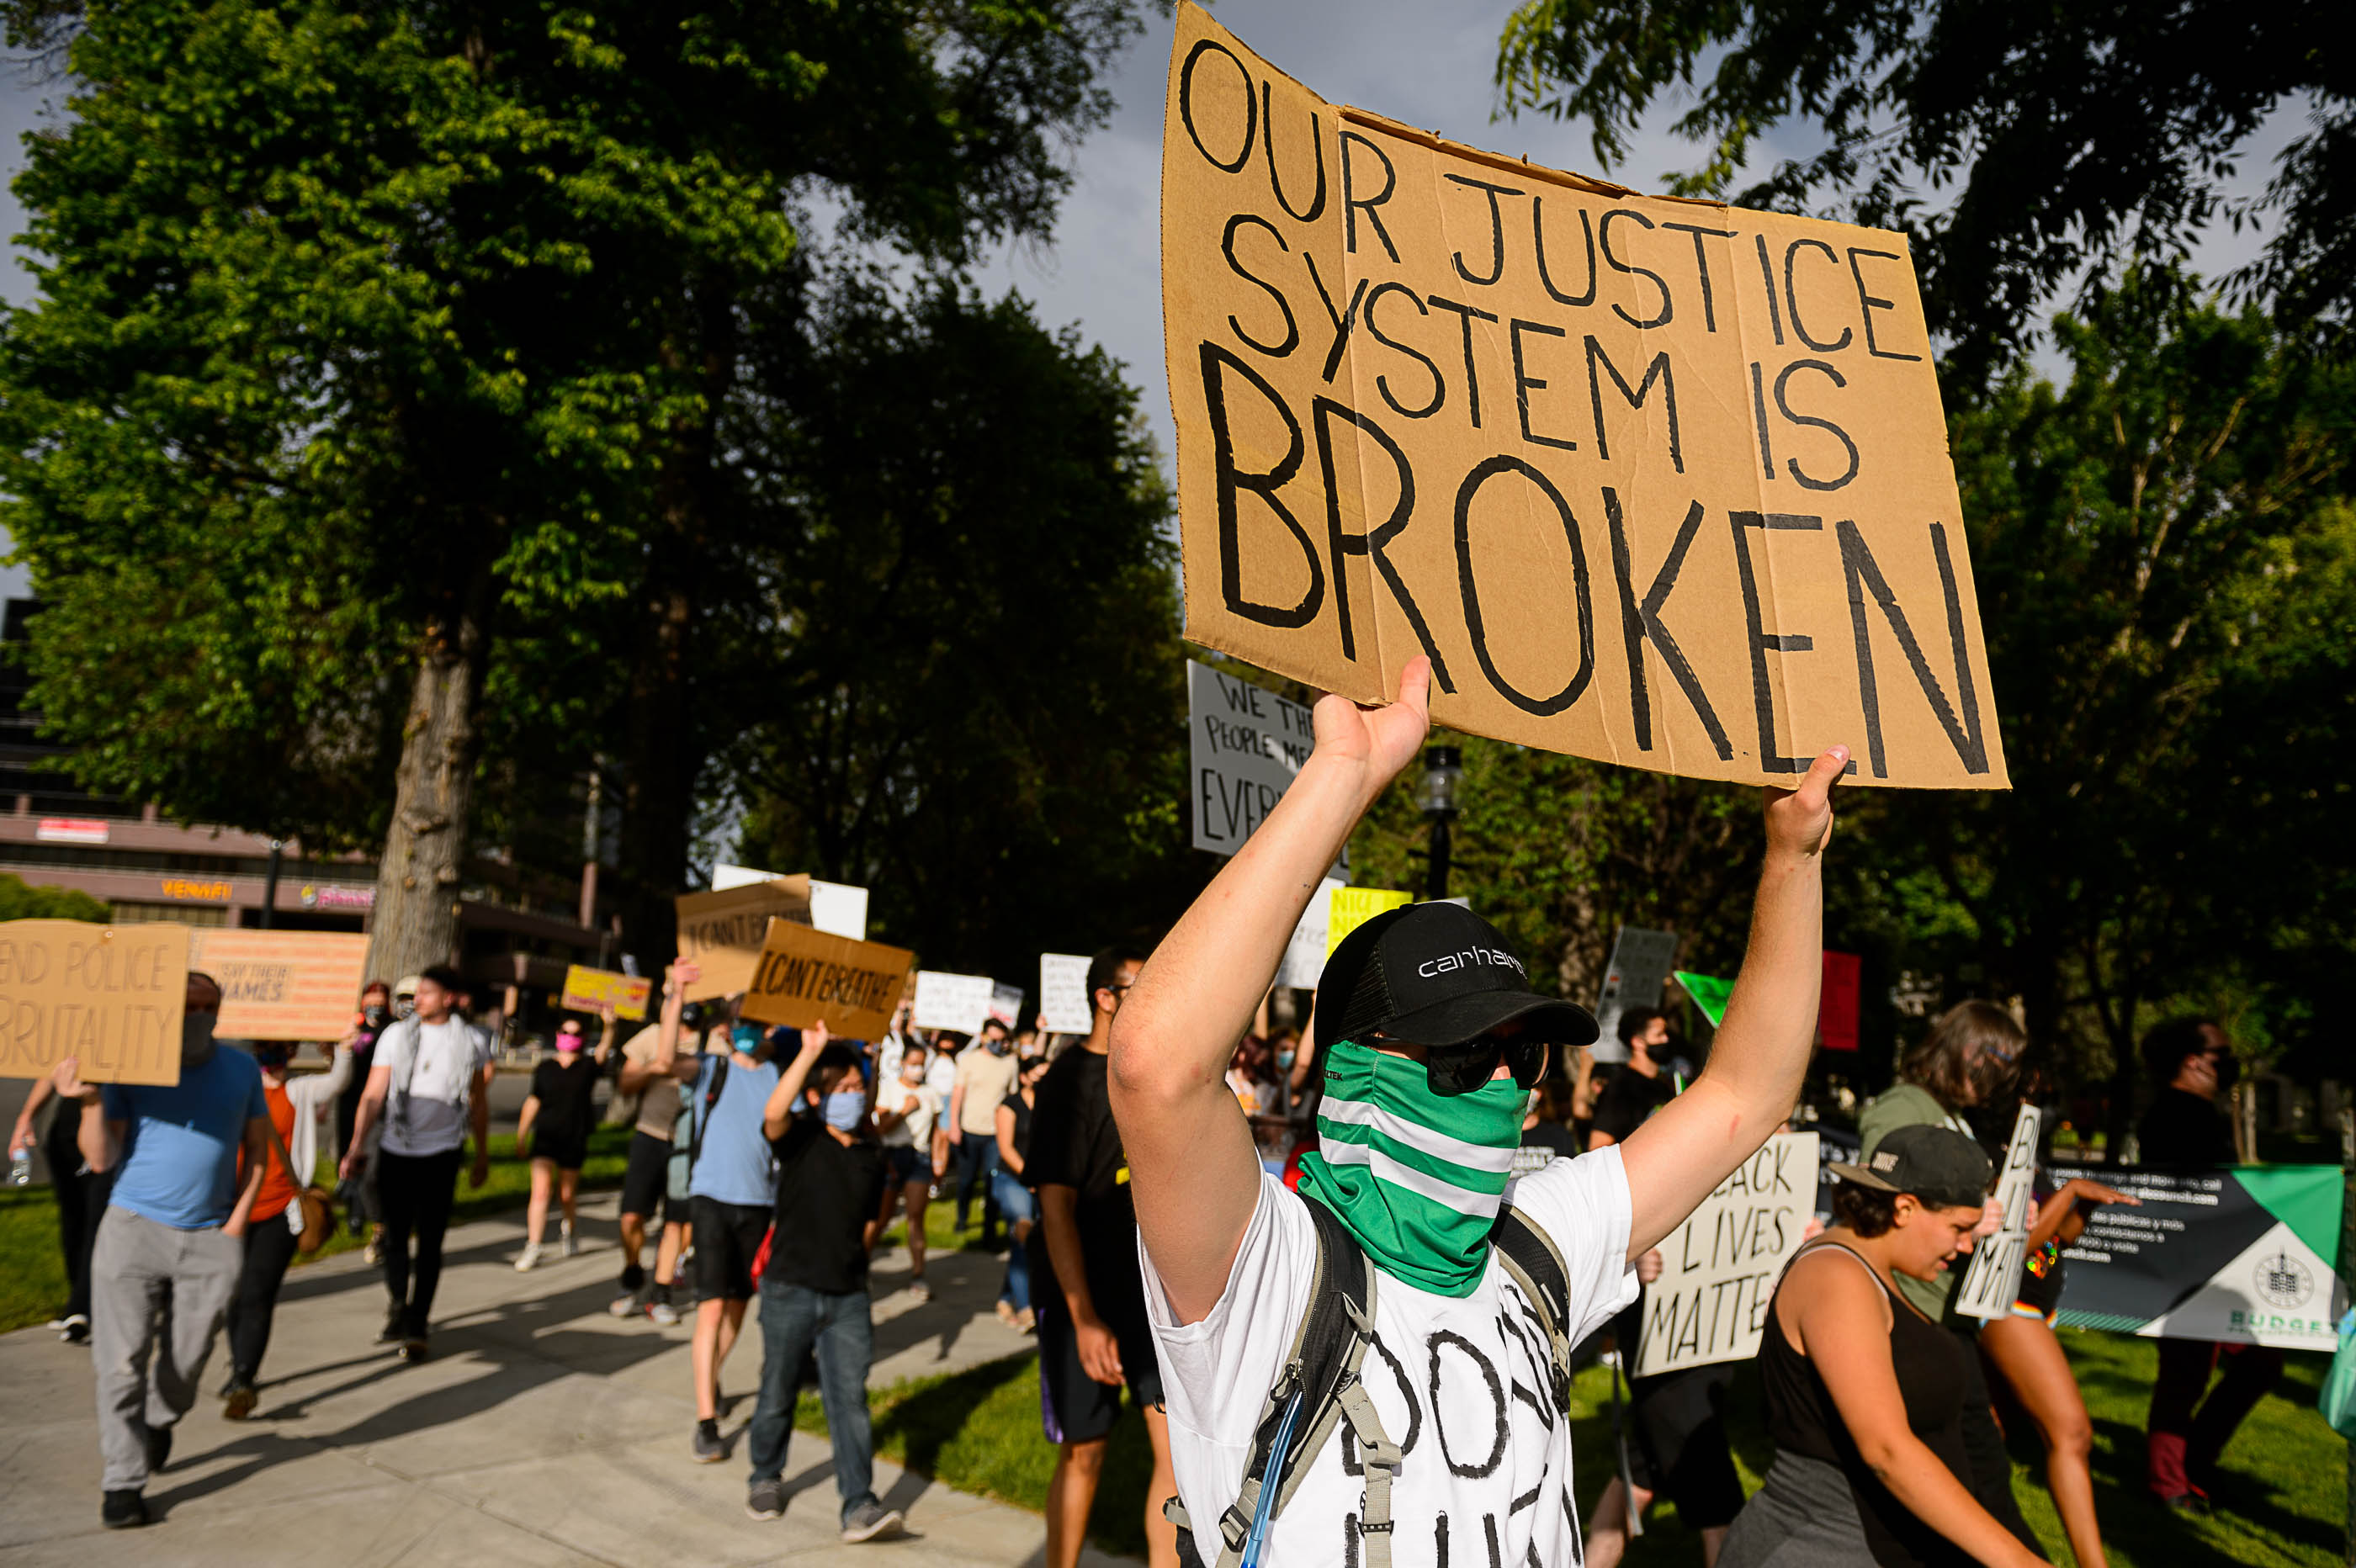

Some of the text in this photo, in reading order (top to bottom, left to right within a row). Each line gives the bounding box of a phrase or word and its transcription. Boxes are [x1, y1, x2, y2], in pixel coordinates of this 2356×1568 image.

[1179, 38, 1923, 363] OUR JUSTICE
[1220, 213, 1860, 492] SYSTEM IS
[1198, 340, 1990, 780] BROKEN
[1216, 672, 1266, 718] WE
[1205, 715, 1275, 760] PEOPLE
[1201, 767, 1286, 841] EVER
[64, 940, 171, 992] POLICE
[0, 994, 177, 1071] BRUTALITY
[1712, 1141, 1793, 1200] ACK
[1682, 1205, 1794, 1274] LIVES
[1636, 1270, 1770, 1376] MATTE
